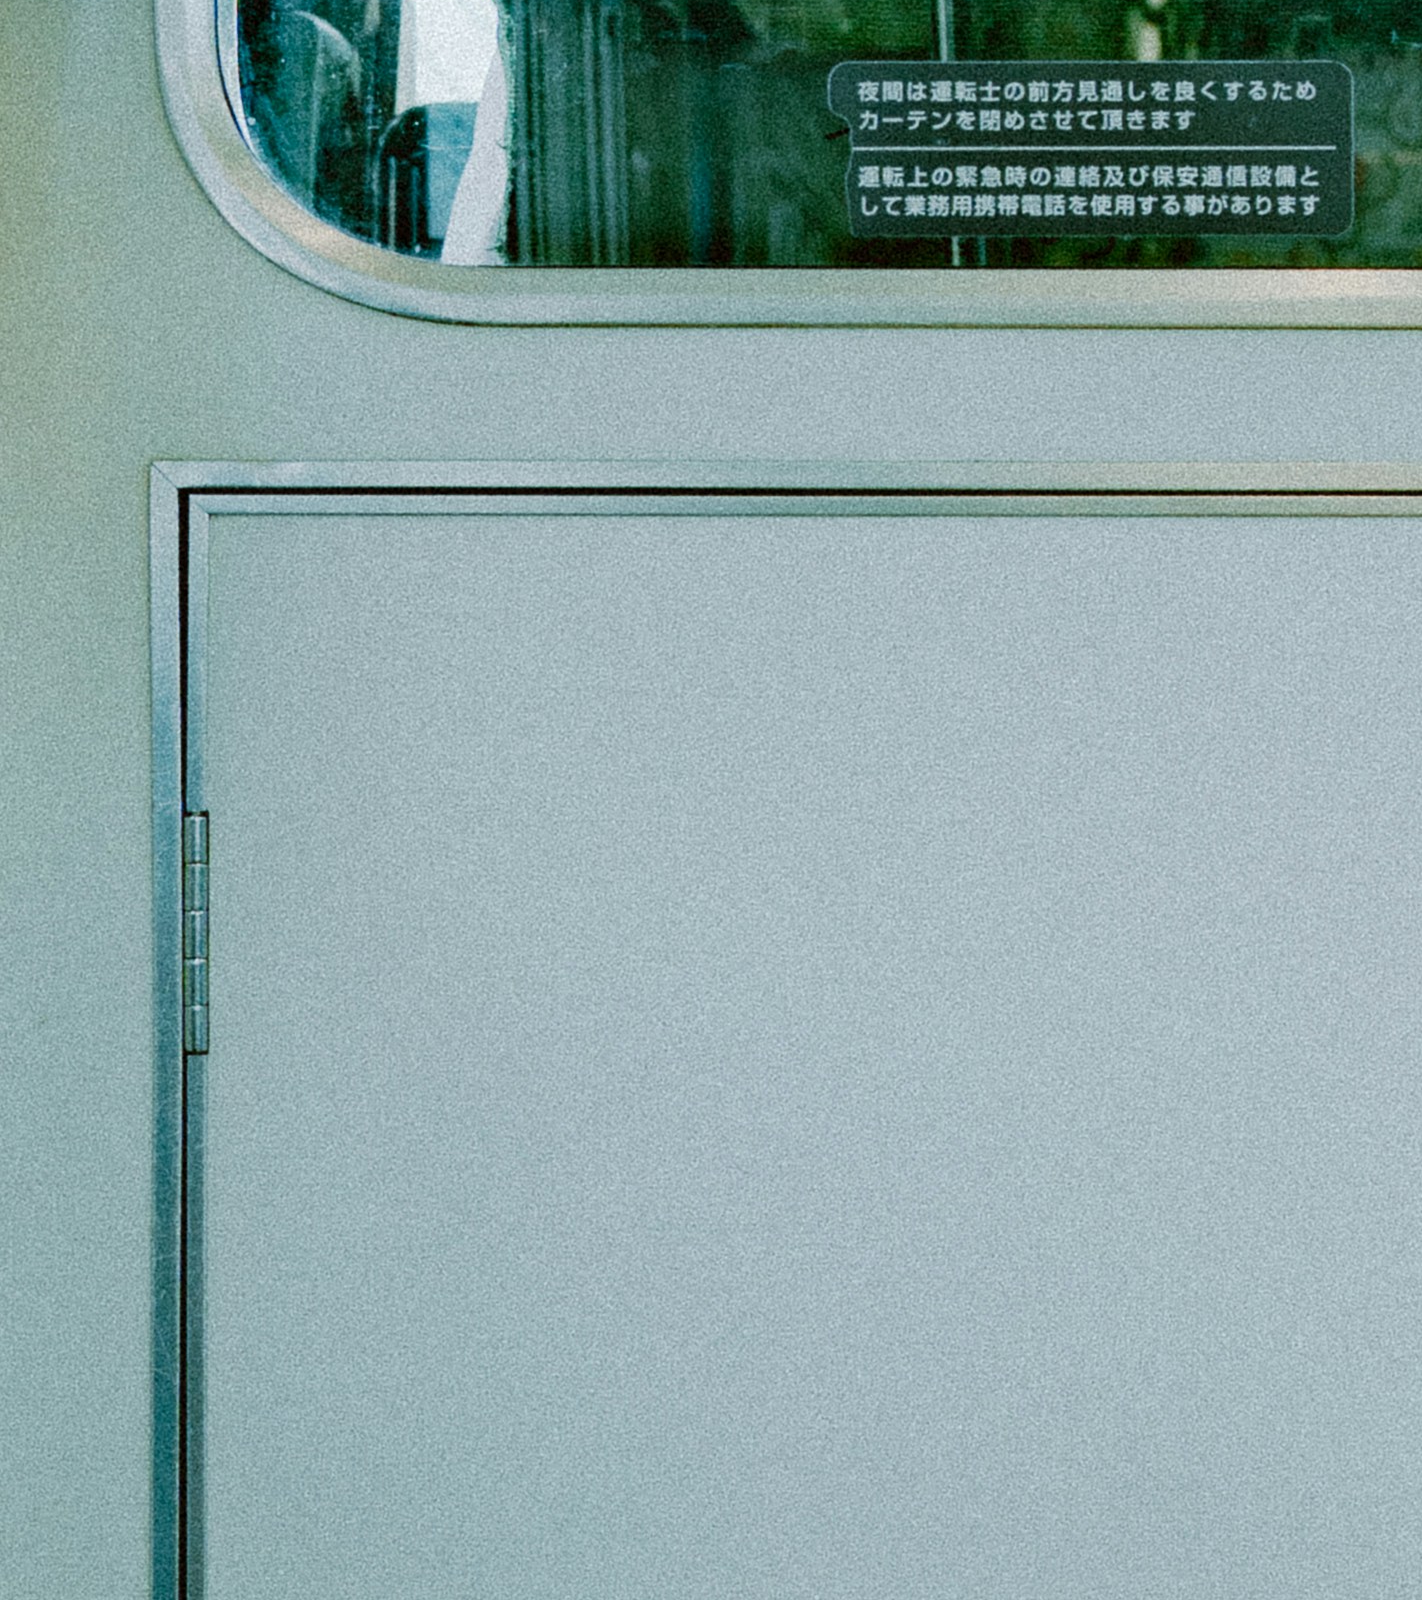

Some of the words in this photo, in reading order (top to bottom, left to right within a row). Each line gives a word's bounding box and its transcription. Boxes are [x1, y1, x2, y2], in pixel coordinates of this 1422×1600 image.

[858, 80, 1317, 102] 夜間は運転士の前方見通しを良くするため
[859, 110, 1196, 131] カーテンを閉めさせて頂きます
[858, 165, 1319, 188] 運転上の緊急時の連絡及び保安通信設備と
[860, 194, 1320, 217] して業務用携帯電話を使用する事があります
